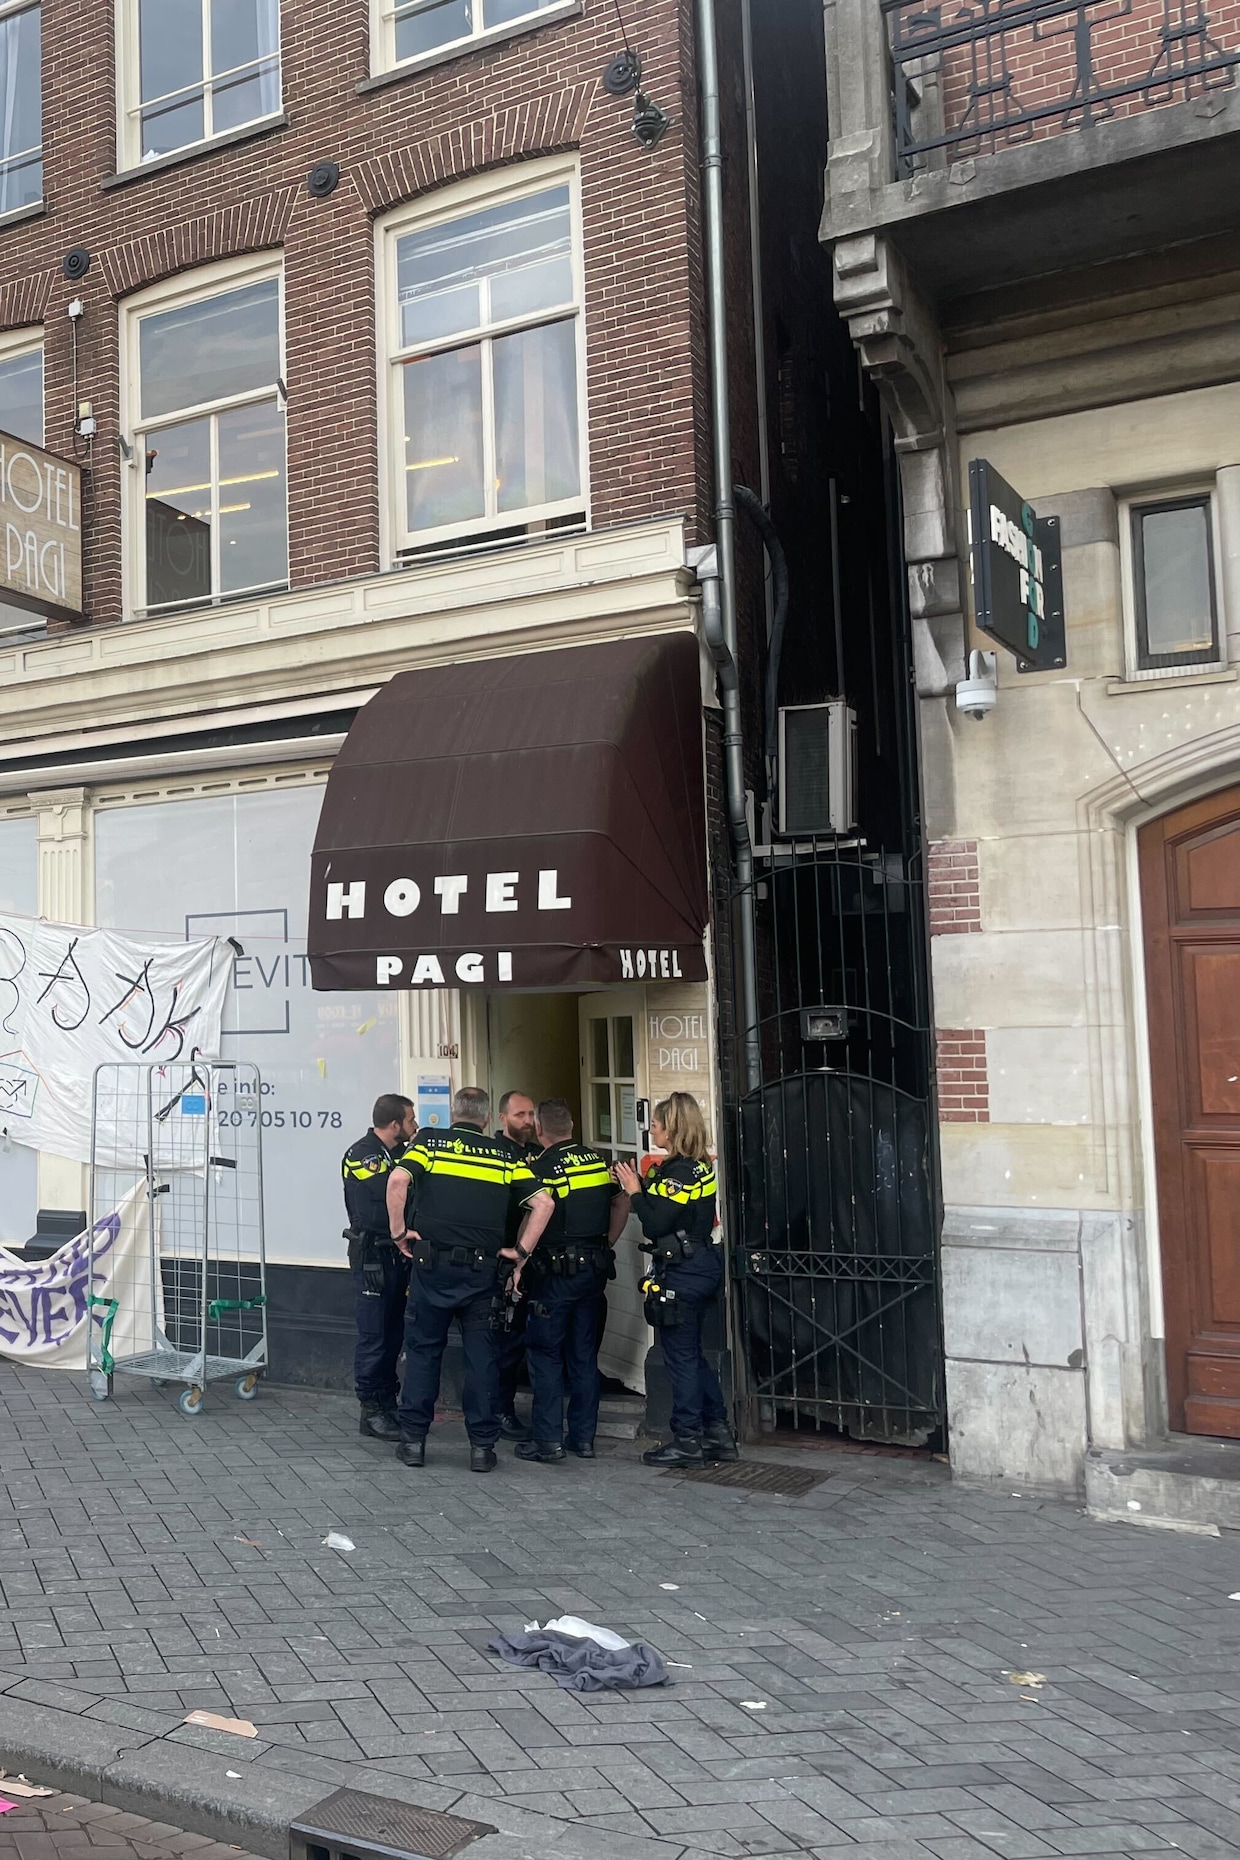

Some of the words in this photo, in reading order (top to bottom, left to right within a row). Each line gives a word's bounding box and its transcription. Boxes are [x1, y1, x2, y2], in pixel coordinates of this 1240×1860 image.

[6, 522, 66, 599] PAGI
[326, 869, 572, 920] HOTEL
[376, 951, 513, 985] PAGI
[619, 949, 683, 979] HOTEL
[649, 1015, 707, 1039] HOTEL
[659, 1047, 698, 1071] PAGI
